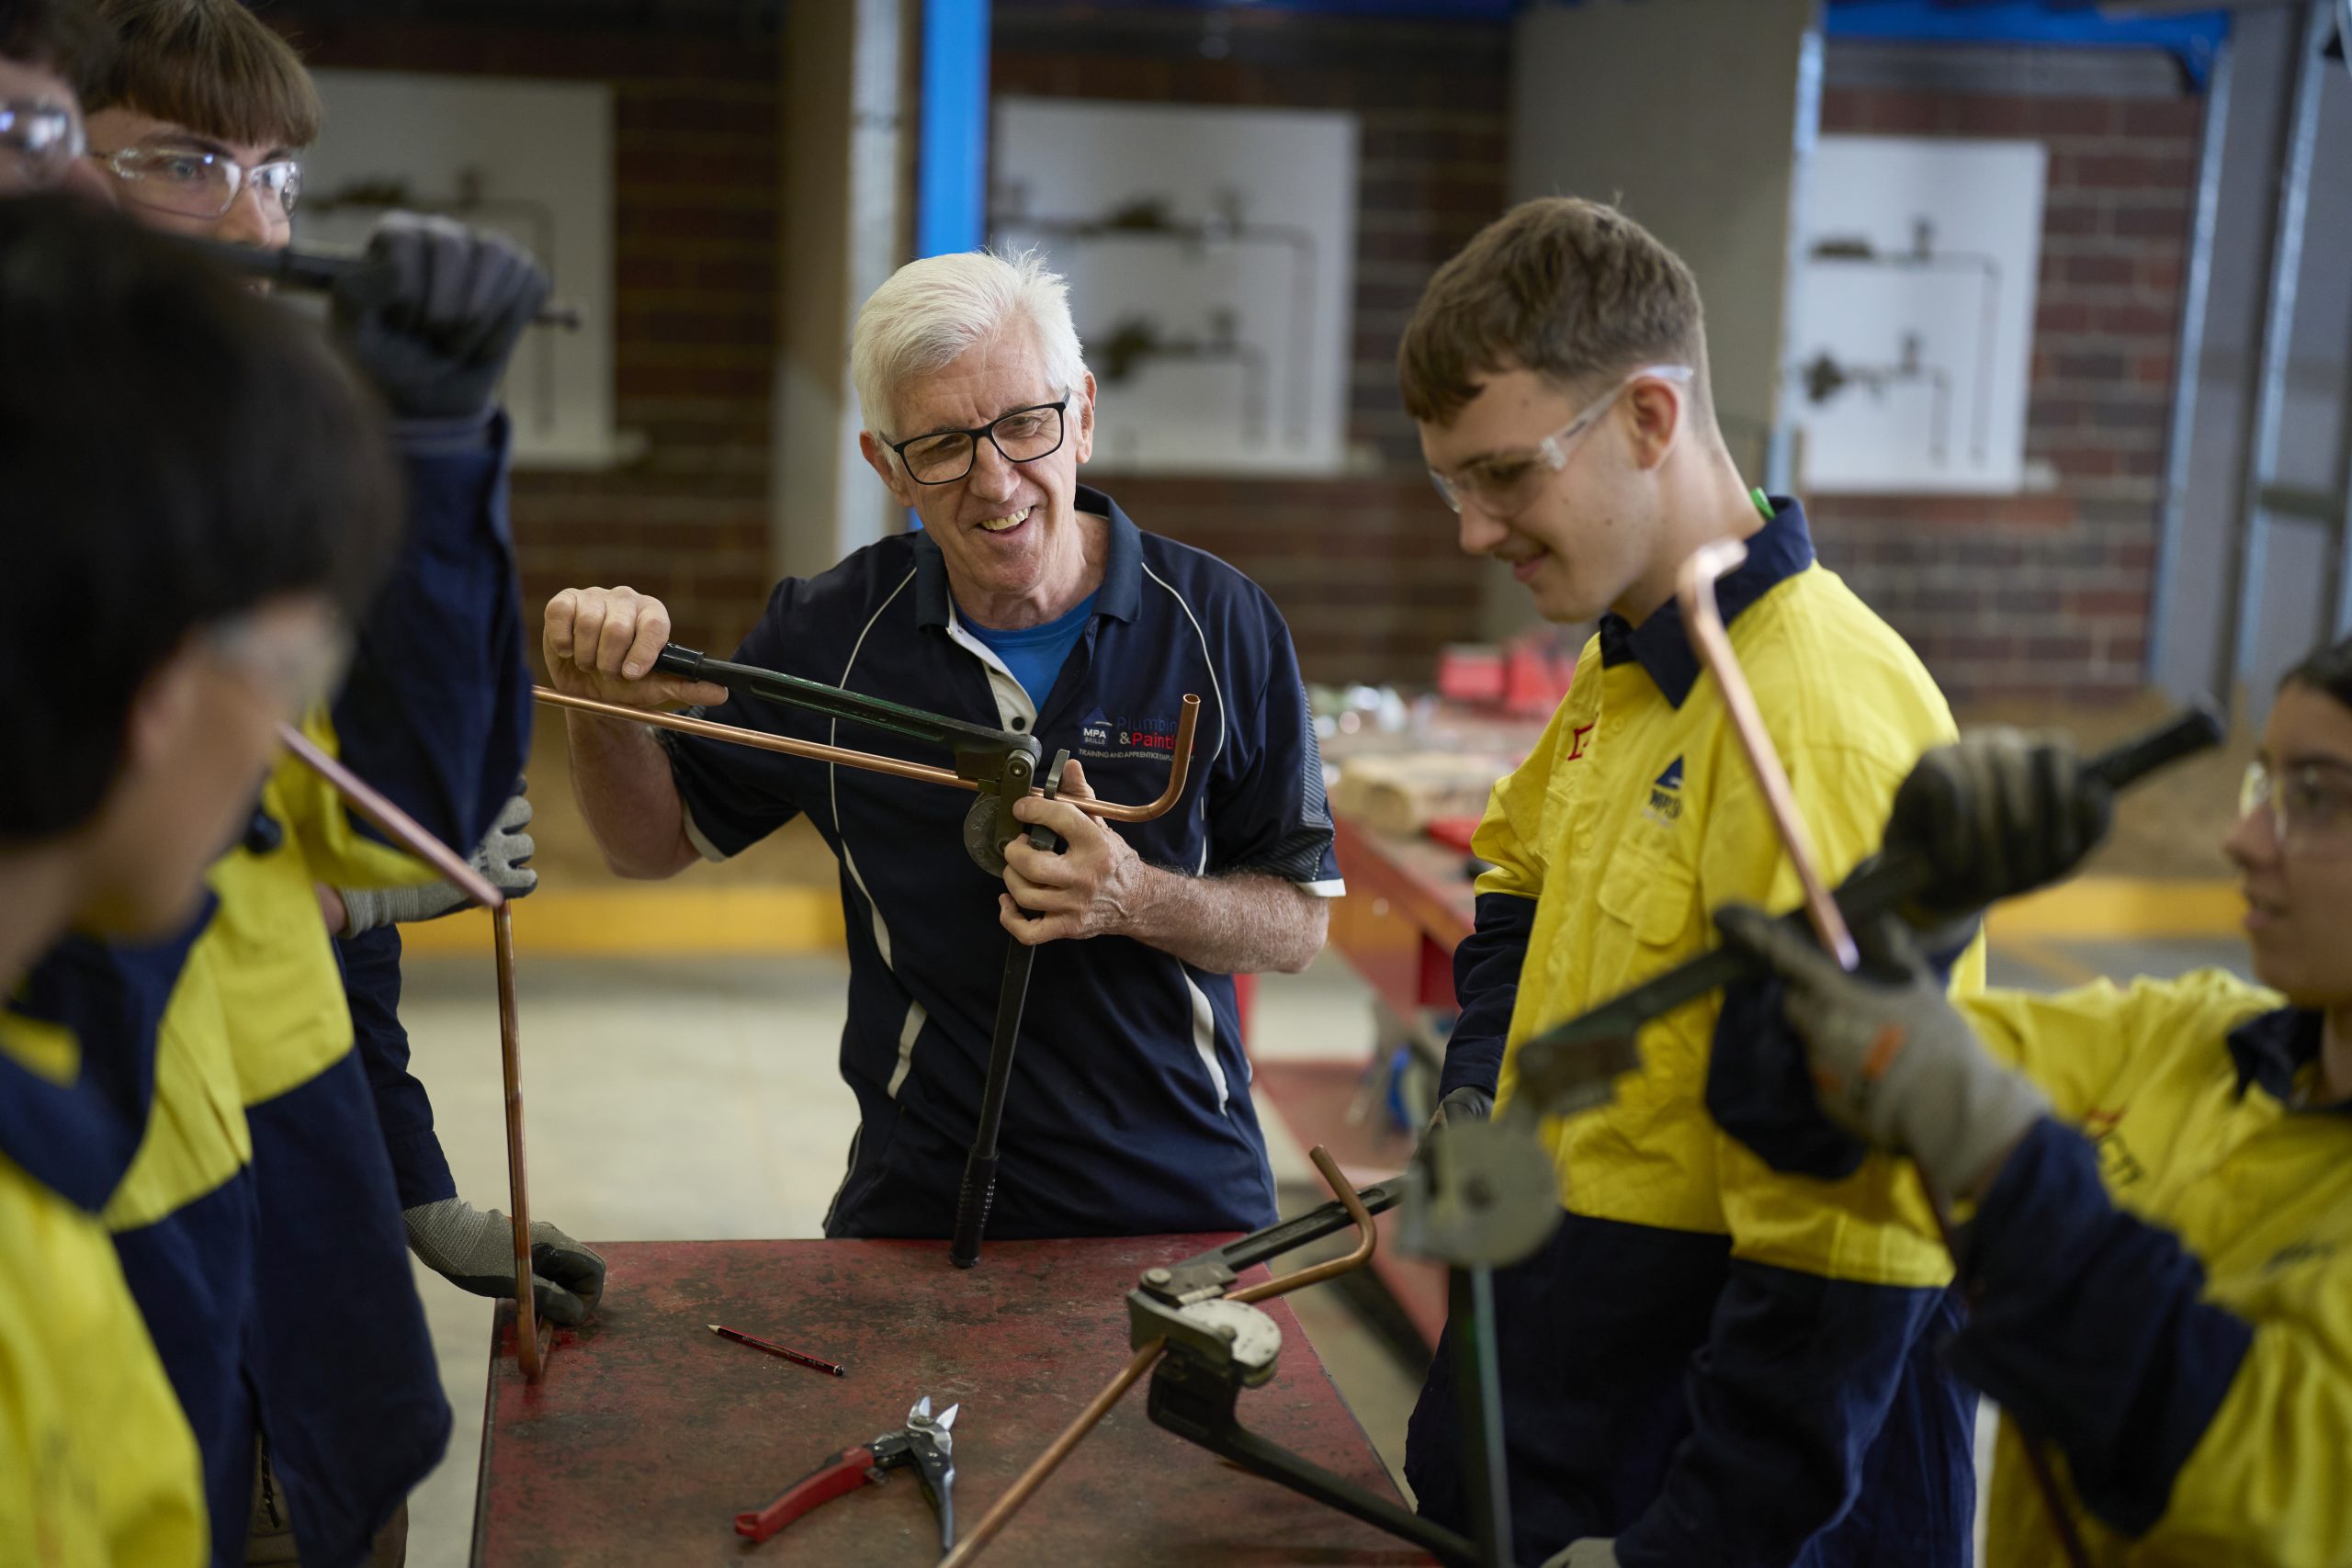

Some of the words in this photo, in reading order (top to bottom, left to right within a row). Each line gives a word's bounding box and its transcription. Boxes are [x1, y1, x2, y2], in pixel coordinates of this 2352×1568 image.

[1116, 716, 1178, 732] Plumbin
[1083, 728, 1107, 739] MPA
[1084, 737, 1106, 745] SKILLS
[1079, 749, 1109, 759] TRAINING
[1110, 750, 1124, 759] AND
[1125, 750, 1159, 761] APPRENTICE
